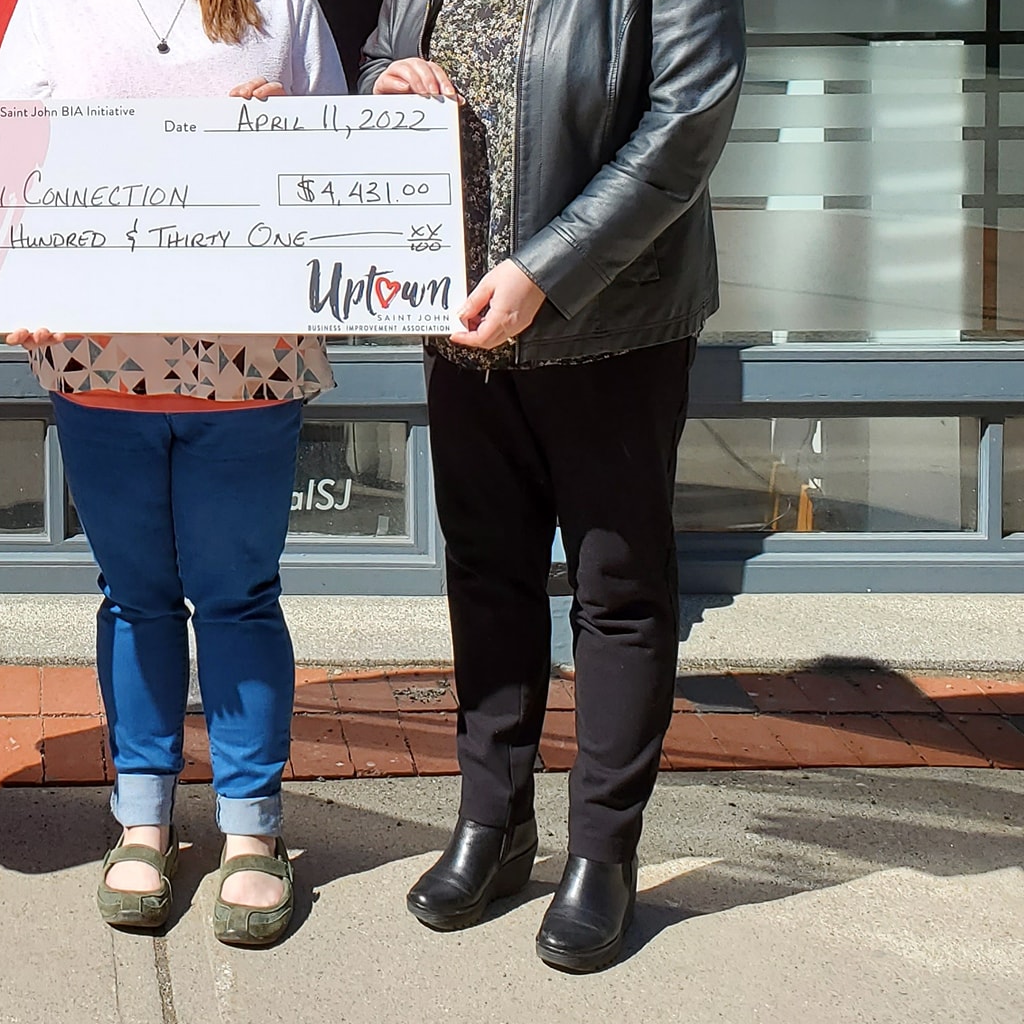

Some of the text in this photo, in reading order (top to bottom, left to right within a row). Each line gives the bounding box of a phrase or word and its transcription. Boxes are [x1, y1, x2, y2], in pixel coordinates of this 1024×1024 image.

[0, 107, 28, 118] Saint
[31, 106, 58, 118] John
[61, 106, 83, 117] BIA
[86, 105, 136, 117] Initiative
[164, 120, 197, 133] Date
[24, 170, 189, 208] CONNECTION
[297, 175, 429, 206] $4,431.00
[377, 314, 450, 322] SAINT JOHN
